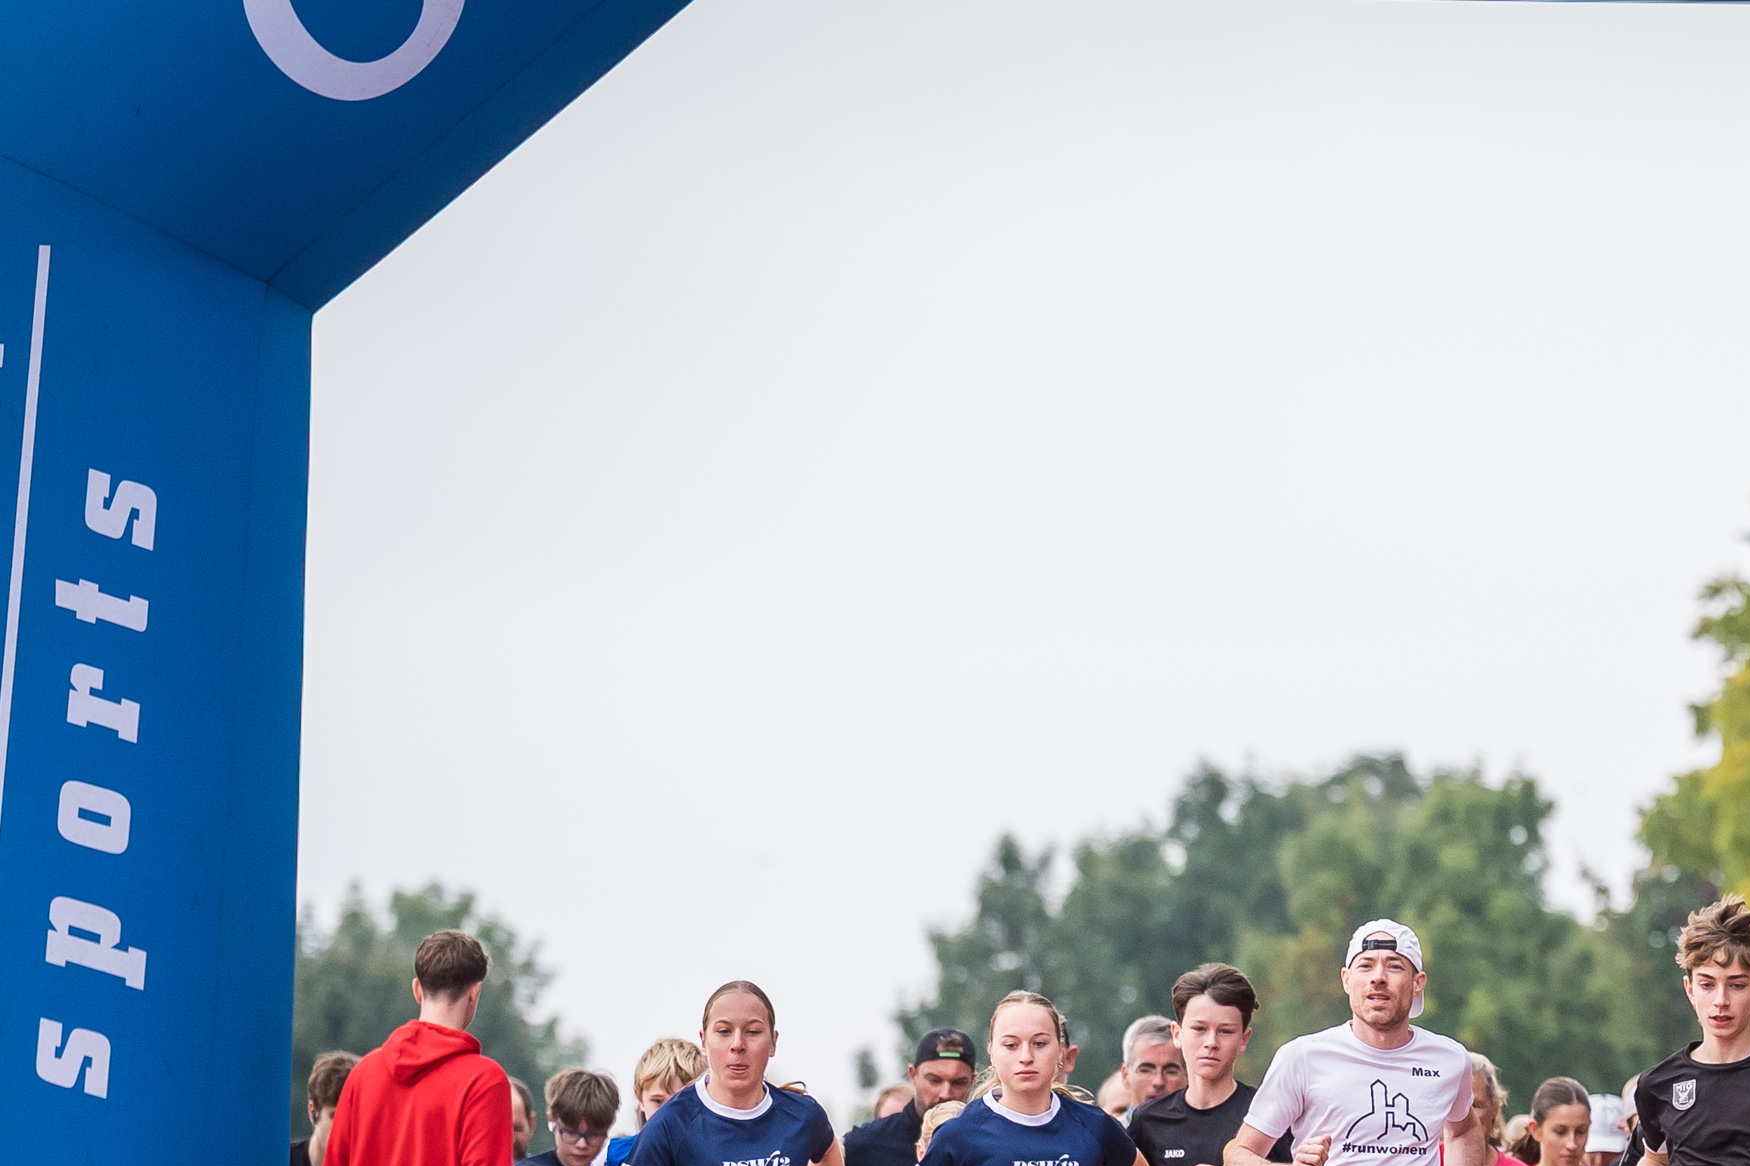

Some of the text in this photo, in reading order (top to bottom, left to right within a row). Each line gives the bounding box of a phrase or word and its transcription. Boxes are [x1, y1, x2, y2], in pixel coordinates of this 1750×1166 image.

[37, 467, 158, 1100] sports
[1411, 1066, 1441, 1078] Max
[1163, 1149, 1185, 1158] JAKO
